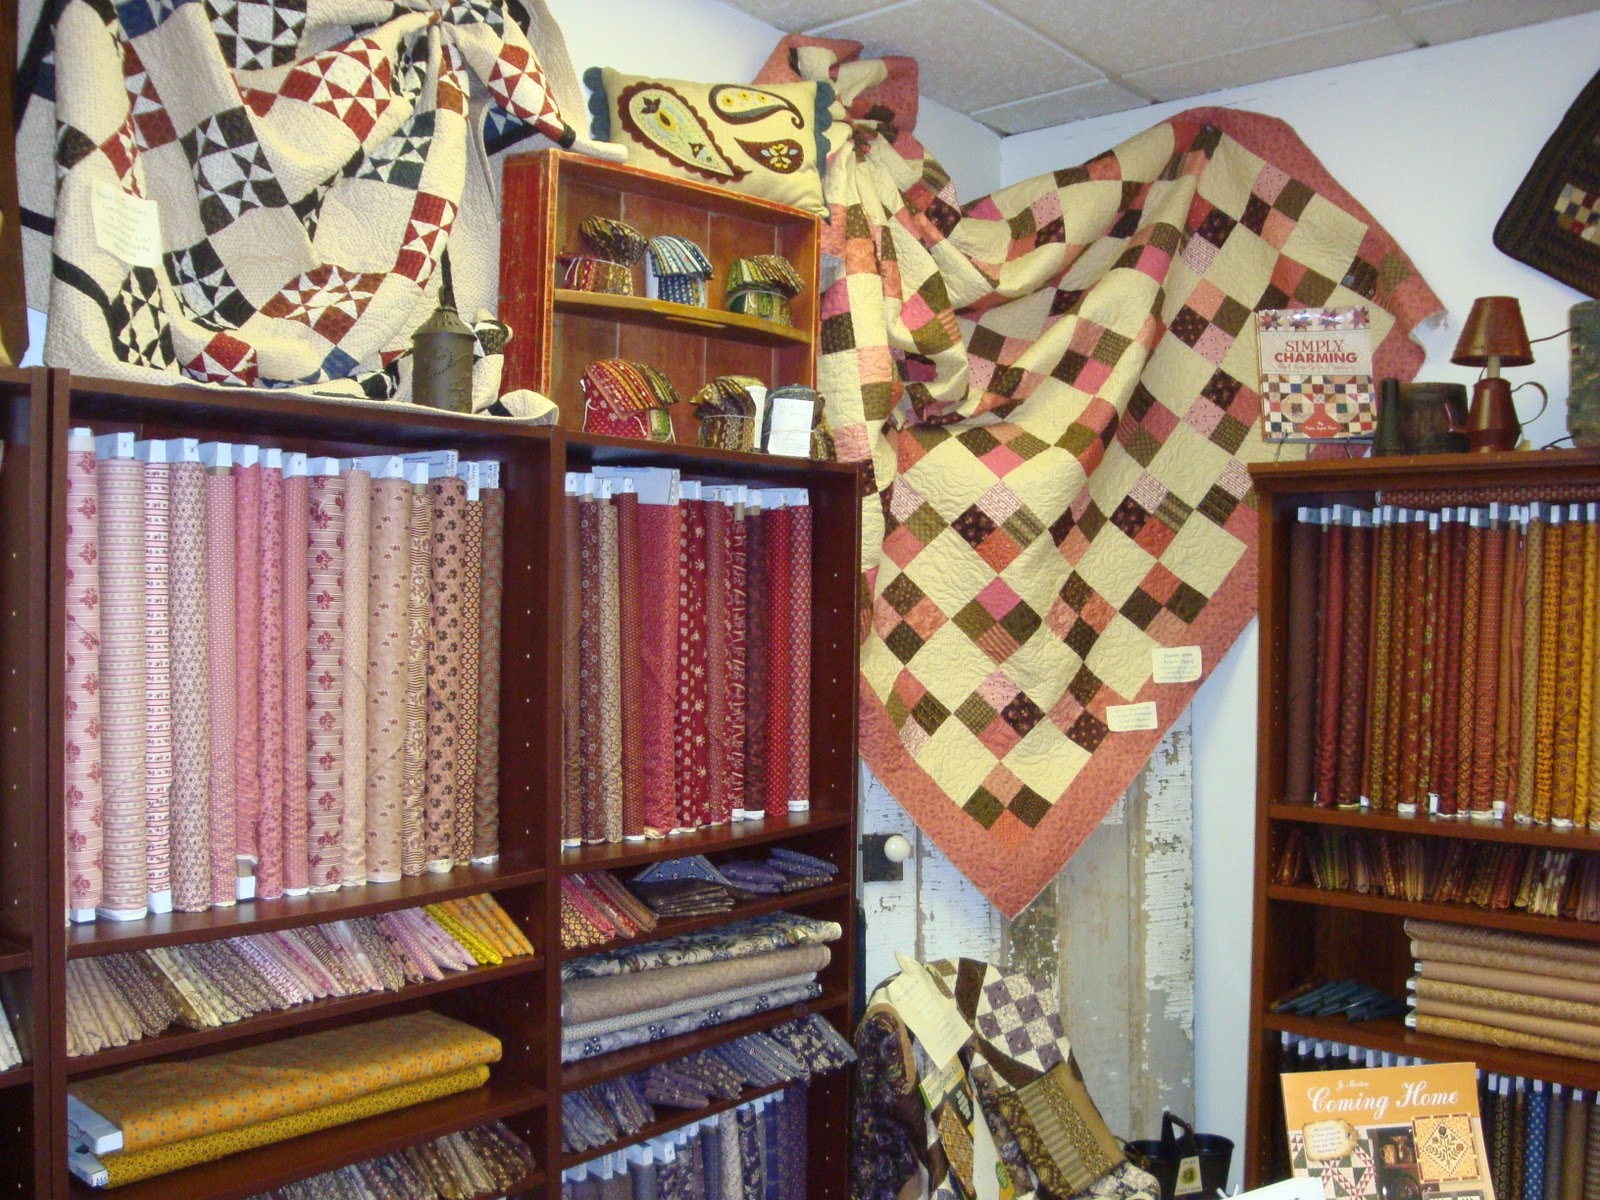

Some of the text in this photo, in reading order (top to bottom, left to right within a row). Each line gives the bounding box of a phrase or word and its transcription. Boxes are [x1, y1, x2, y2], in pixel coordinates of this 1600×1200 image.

[1285, 340, 1344, 352] SIMPLY
[1274, 352, 1358, 363] CHARMING
[1307, 1080, 1459, 1120] Coming Home
